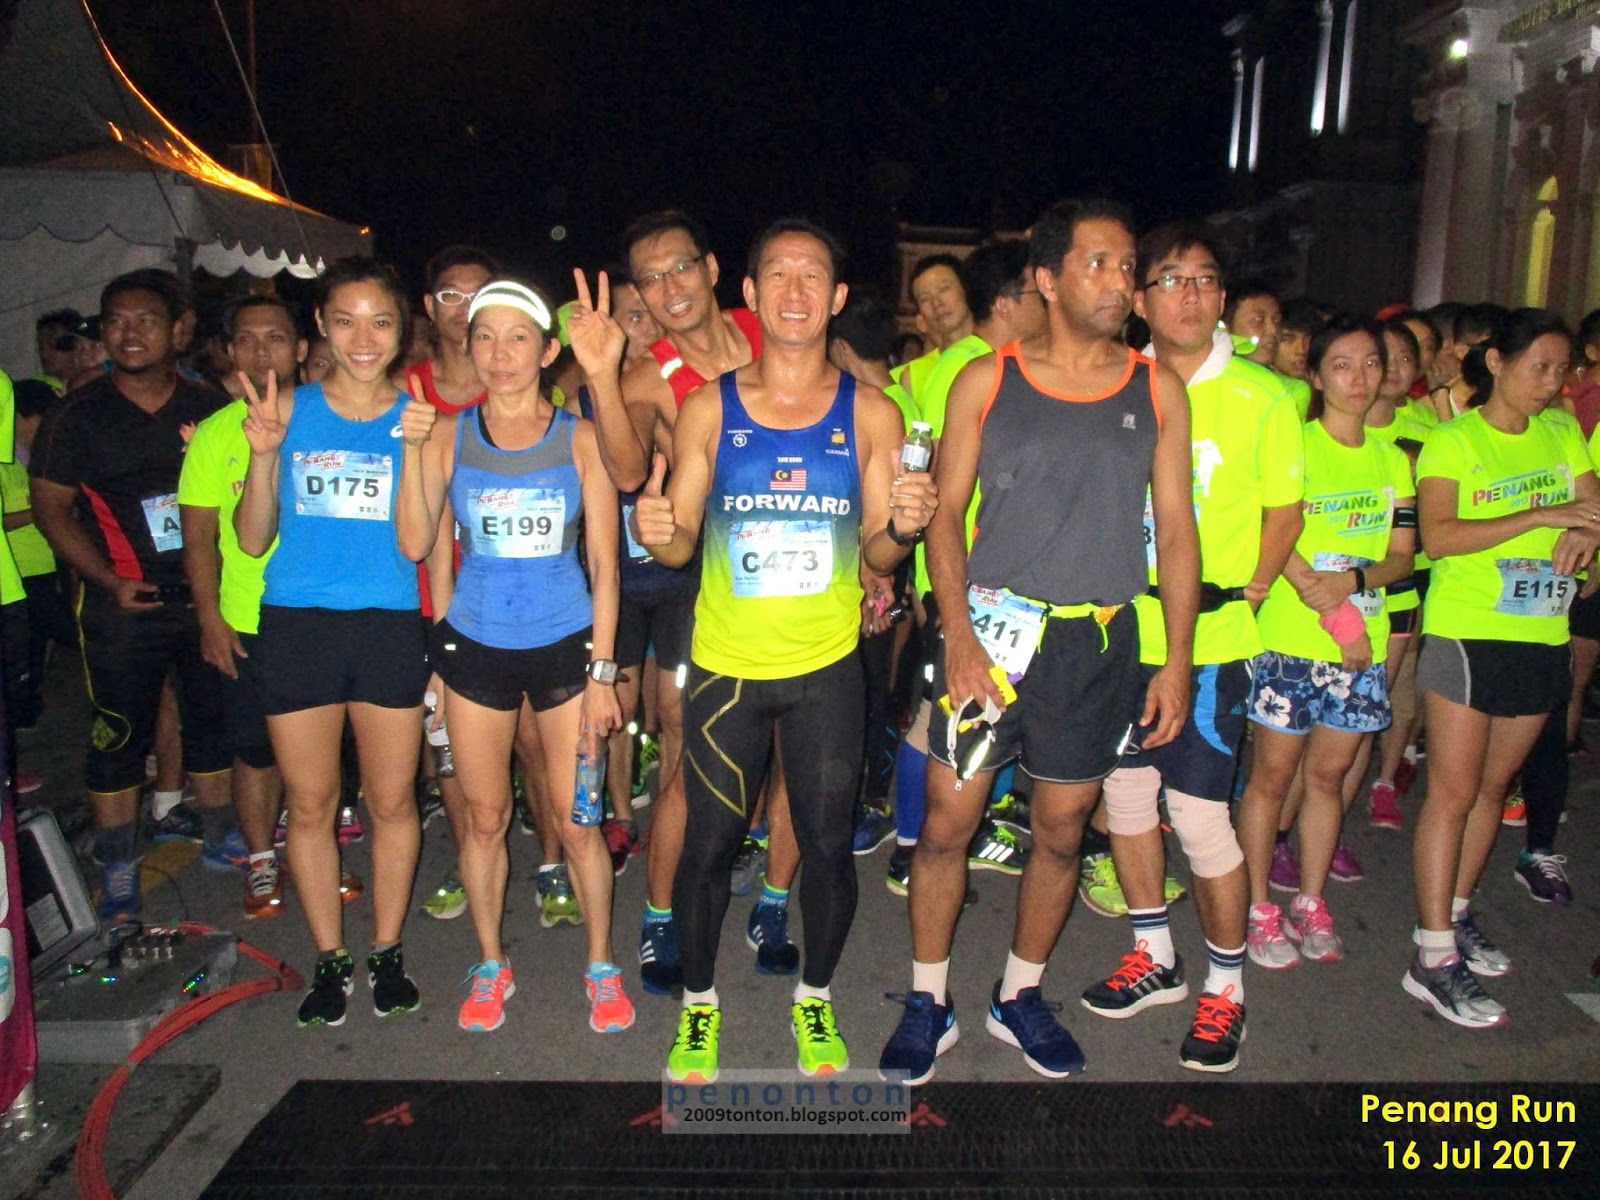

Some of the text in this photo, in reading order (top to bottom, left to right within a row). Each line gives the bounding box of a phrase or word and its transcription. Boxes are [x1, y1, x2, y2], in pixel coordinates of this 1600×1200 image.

[306, 475, 380, 498] D175
[1472, 475, 1556, 506] PENANG
[723, 494, 851, 516] FORWARD
[1530, 488, 1569, 509] RUN
[482, 516, 552, 536] E199
[1347, 511, 1388, 528] RUN
[742, 550, 819, 573] C473
[1513, 580, 1569, 599] E115
